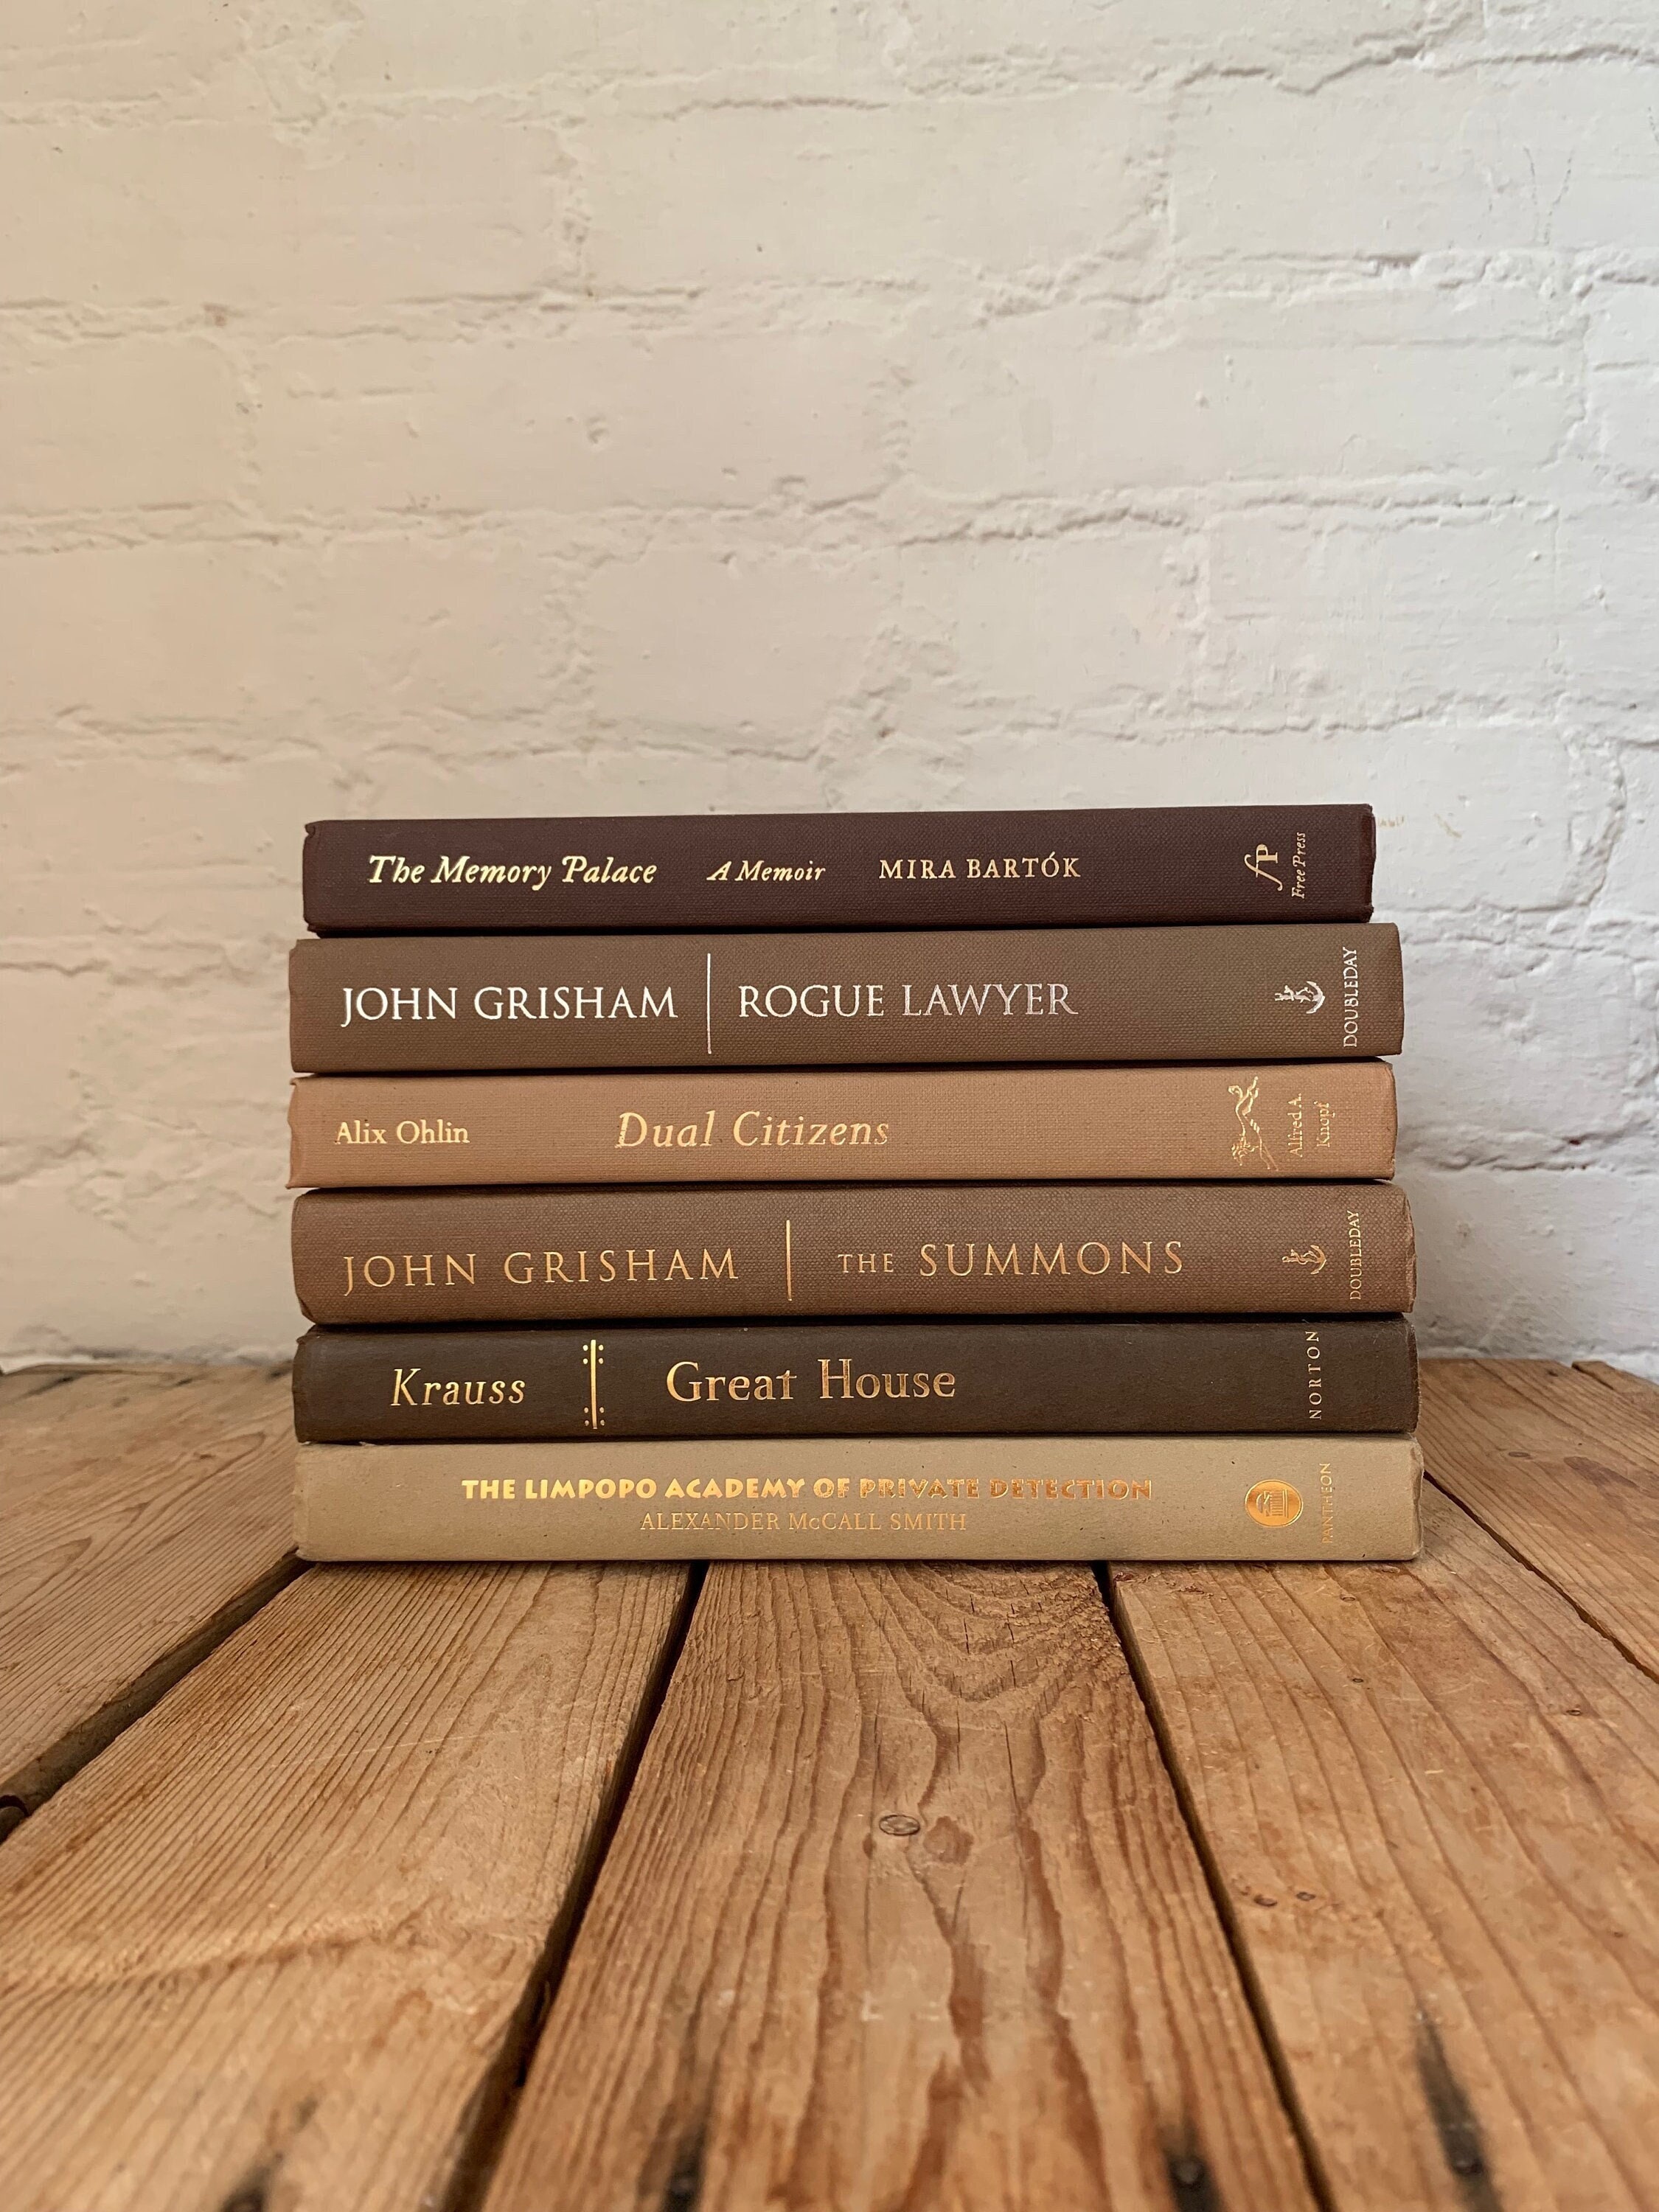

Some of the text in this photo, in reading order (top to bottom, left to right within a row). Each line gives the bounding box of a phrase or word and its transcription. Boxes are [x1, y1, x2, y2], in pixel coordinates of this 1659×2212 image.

[367, 854, 658, 891] The Memory Palace
[706, 860, 827, 883] A Memoir
[879, 852, 1081, 880] MIRA BARTÓK
[1291, 832, 1306, 900] Free Press
[341, 987, 679, 1028] JOHN GRISHAM
[738, 982, 1079, 1018] ROGUE LAWYER
[1342, 946, 1358, 1048] DOUBLEDAY
[335, 1119, 470, 1144] Alix Ohlin
[614, 1110, 890, 1149] Dual Citizens
[1287, 1112, 1303, 1158] Alfred
[1313, 1101, 1335, 1148] Knopf
[344, 1248, 740, 1296] JOHN GRISHAM
[838, 1240, 1183, 1277] THE SUMMONS
[1346, 1210, 1362, 1300] DOUBLEDAY
[391, 1368, 526, 1406] Krauss
[666, 1357, 957, 1402] Great House
[1305, 1330, 1323, 1420] NORTON
[462, 1478, 1152, 1500] THE LIMPOPO ACADEMY OF PRIVATE DETECTION
[1319, 1462, 1334, 1544] PANTHEON
[639, 1512, 967, 1531] ALEXANDER McCALL SMITH
